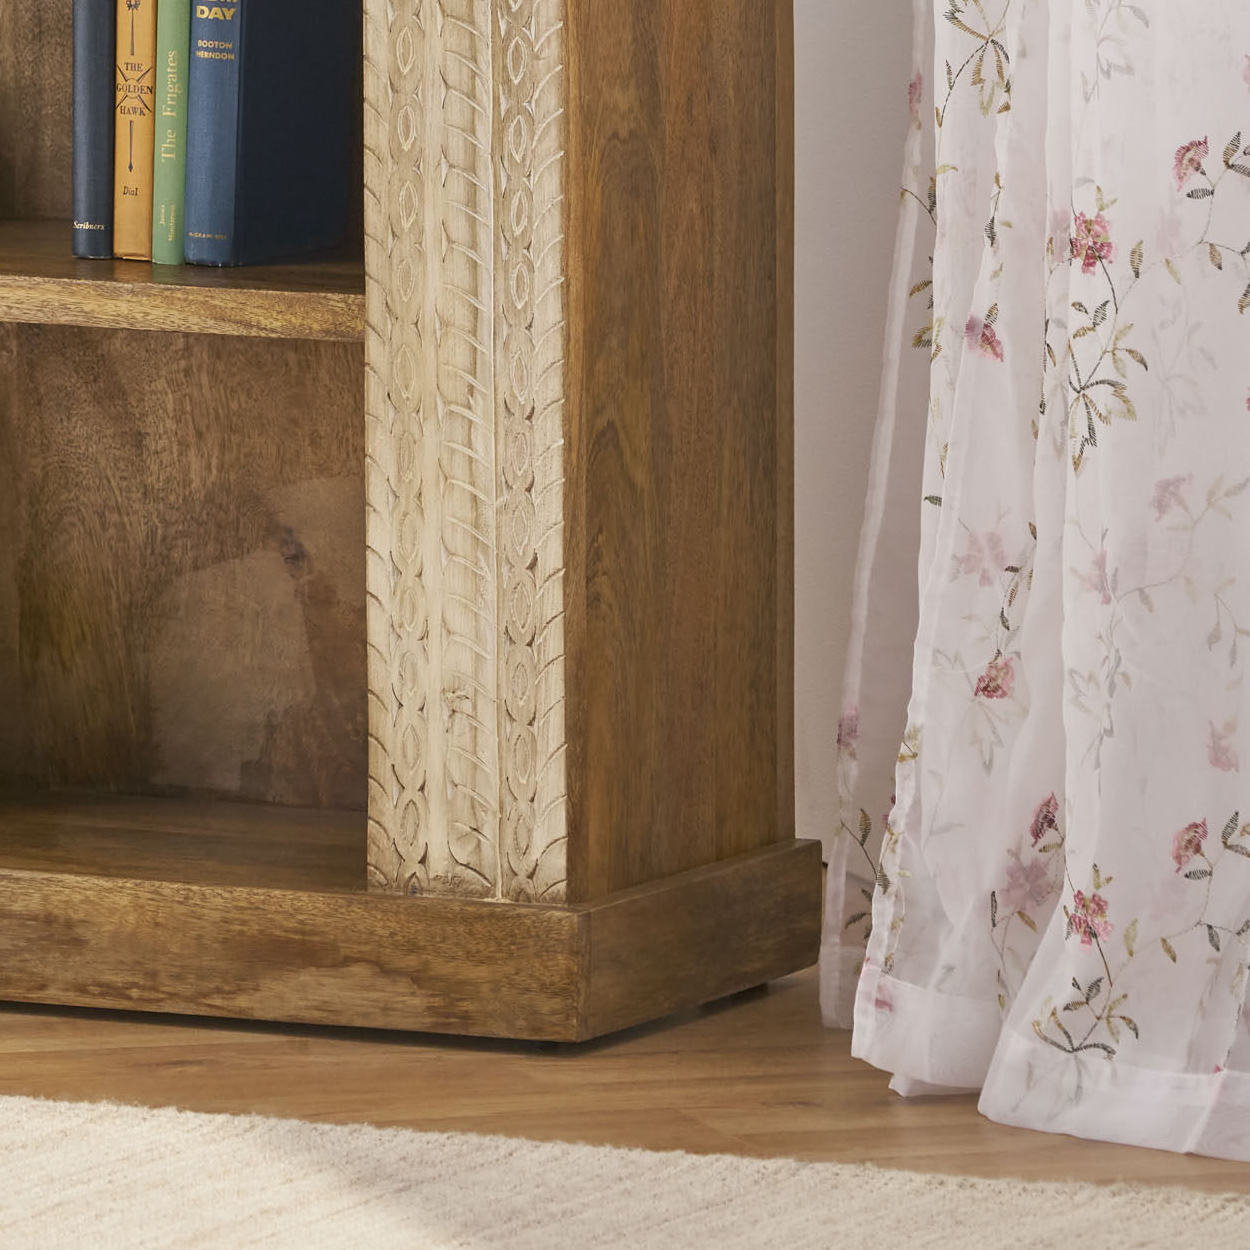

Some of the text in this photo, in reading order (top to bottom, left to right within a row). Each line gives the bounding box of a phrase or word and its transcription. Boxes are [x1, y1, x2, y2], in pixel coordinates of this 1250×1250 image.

[196, 5, 236, 21] DAY
[197, 39, 233, 49] BOOTON
[195, 50, 235, 60] HERNDON
[124, 62, 143, 72] THE
[116, 83, 153, 95] GOLDEN
[120, 105, 146, 116] HAWK
[161, 50, 183, 163] The Frigates
[122, 185, 138, 197] Dial
[72, 220, 105, 230] Scribners
